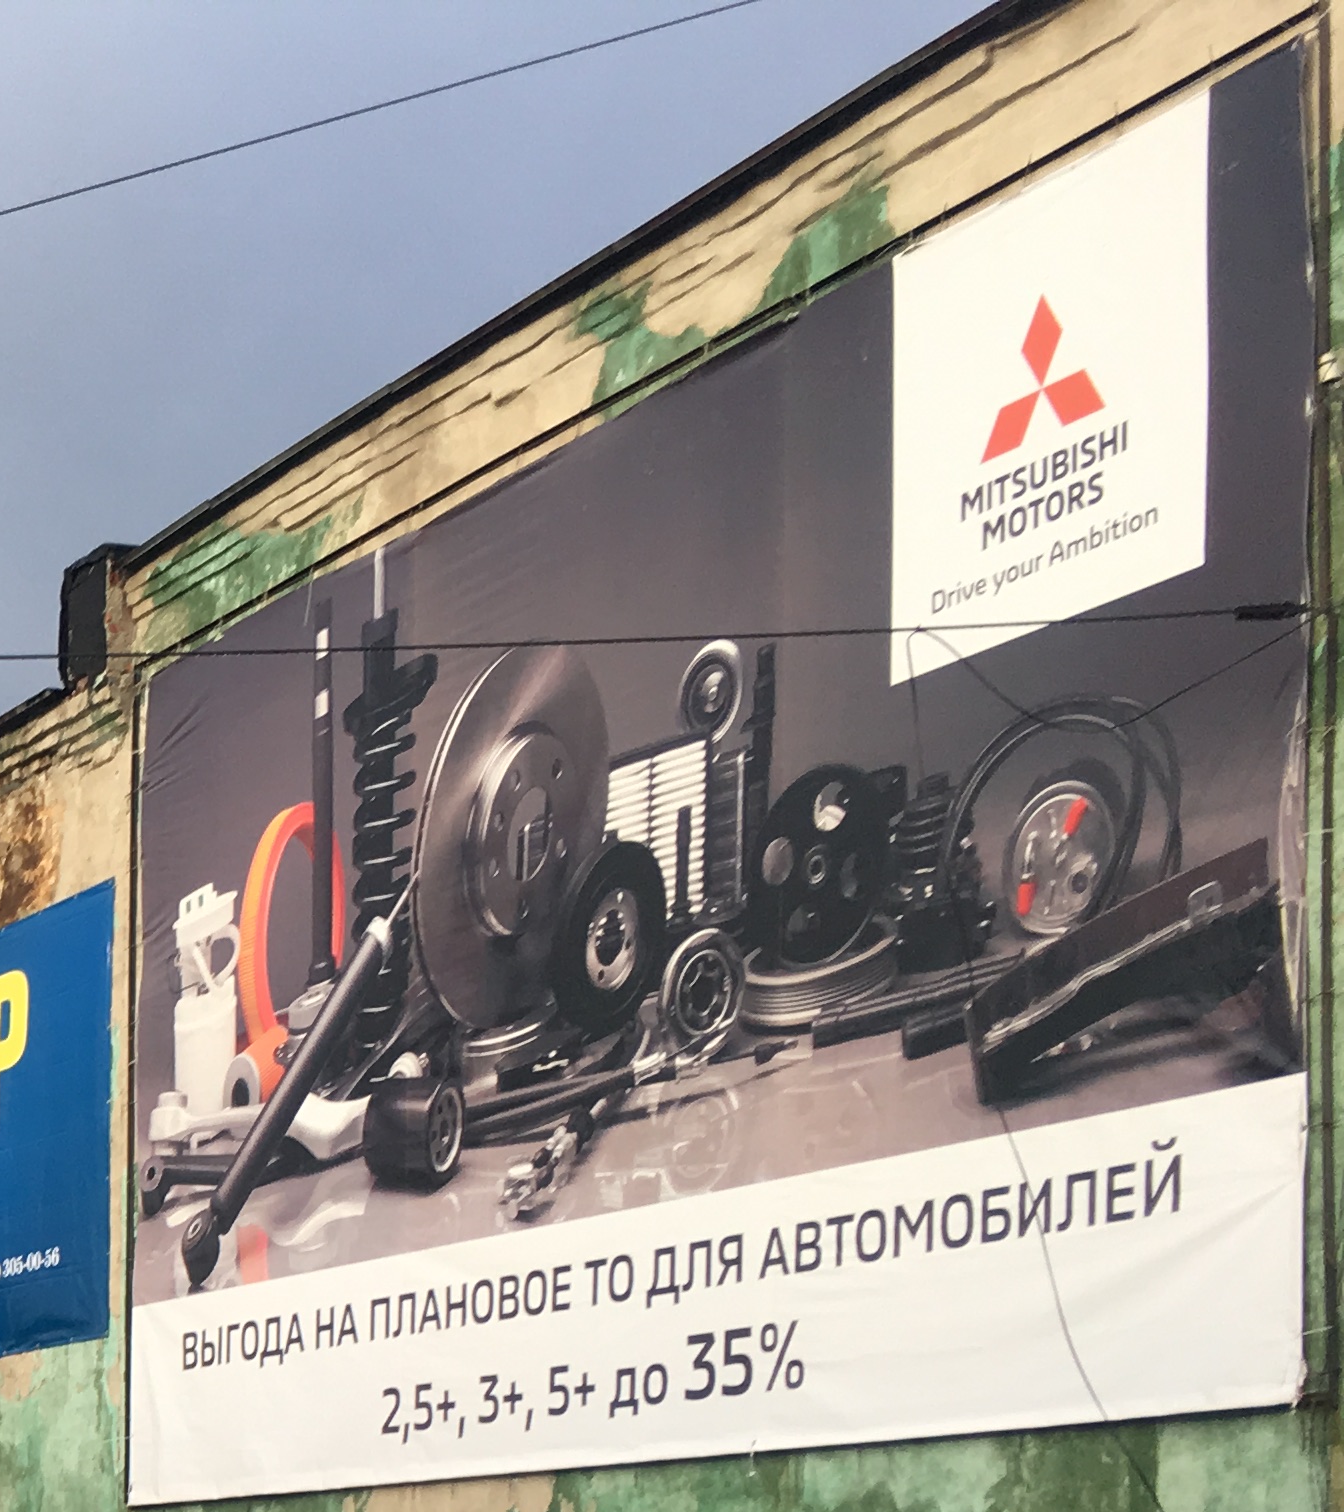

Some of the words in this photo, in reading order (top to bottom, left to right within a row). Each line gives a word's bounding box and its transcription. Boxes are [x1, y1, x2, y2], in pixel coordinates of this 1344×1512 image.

[959, 419, 1129, 522] MITSUBISHI
[981, 472, 1104, 552] MOTORS
[931, 573, 987, 615] Drive
[992, 553, 1043, 596] your
[1048, 506, 1159, 567] Ambition
[2, 1246, 61, 1278] 305-00-56
[182, 1313, 305, 1371] ВЫГОДА
[315, 1301, 359, 1350] НА
[370, 1264, 571, 1341] ПЛАНОВОЕ
[585, 1255, 634, 1303] ТО
[647, 1234, 744, 1308] ДЛЯ
[759, 1136, 1184, 1280] АВТОМОБИЛЕЙ
[381, 1383, 466, 1444] 2,5+,
[478, 1374, 535, 1432] 3+,
[548, 1365, 596, 1416] 5+
[609, 1362, 668, 1418] до
[685, 1320, 804, 1401] 35%
